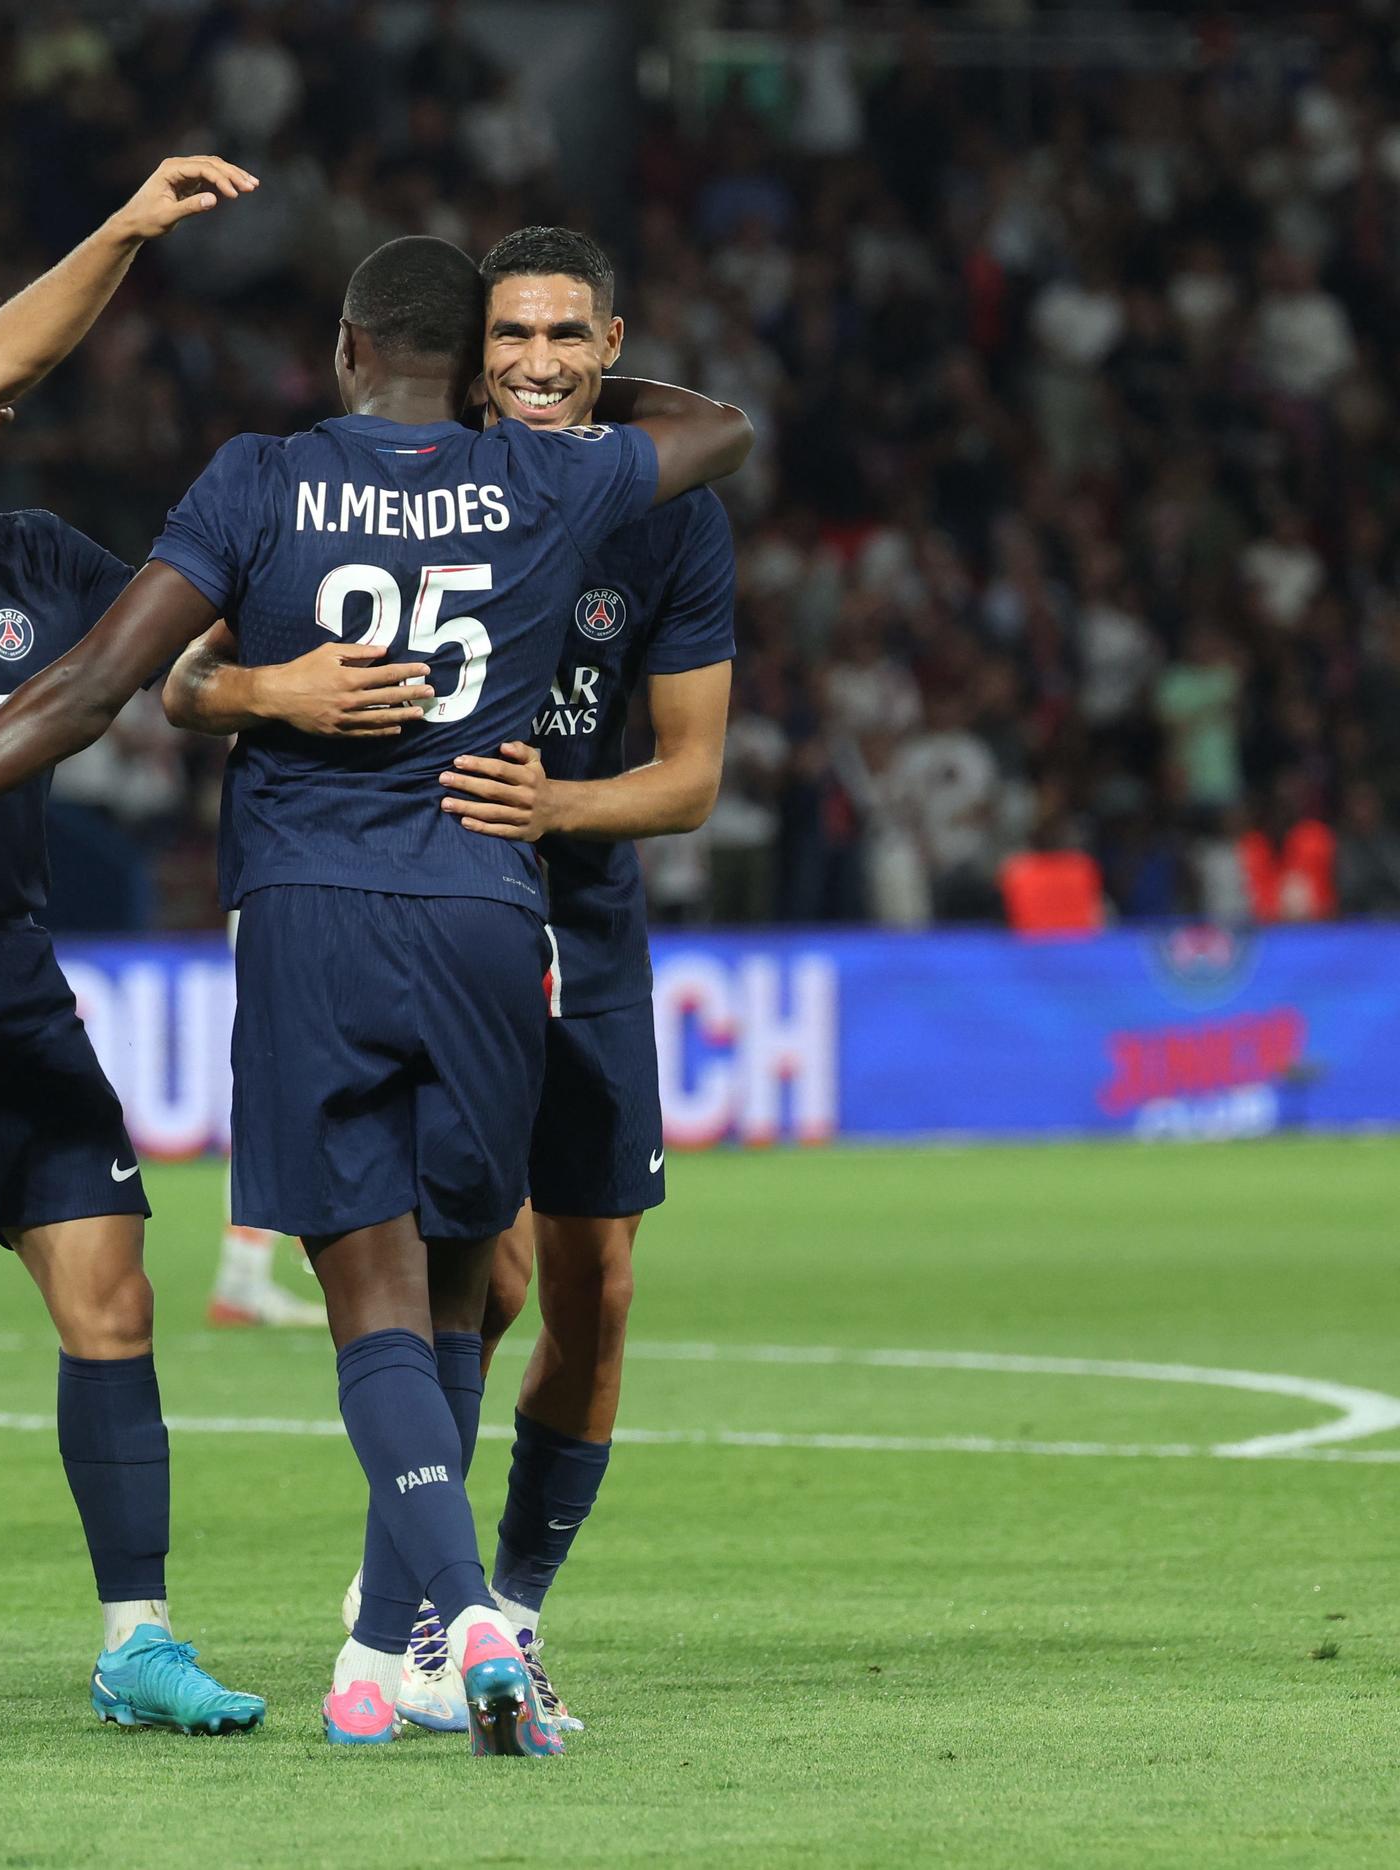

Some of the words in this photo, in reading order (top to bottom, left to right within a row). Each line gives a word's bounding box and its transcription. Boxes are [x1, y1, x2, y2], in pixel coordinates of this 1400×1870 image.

[296, 481, 510, 540] N.MENDES
[586, 591, 619, 605] PARIS
[315, 564, 493, 722] 25
[395, 1465, 449, 1495] PARIS
